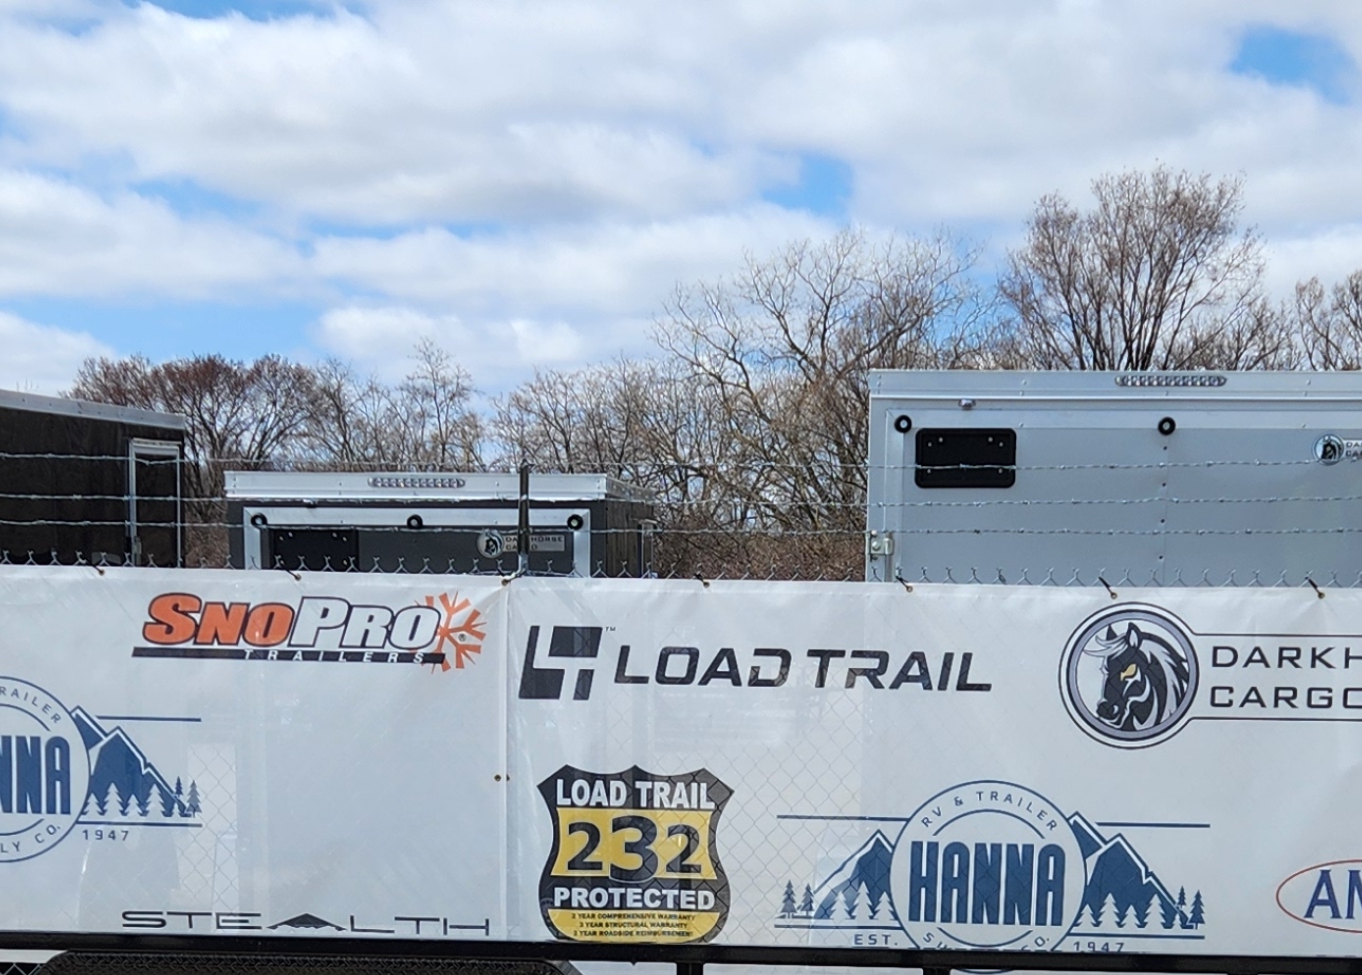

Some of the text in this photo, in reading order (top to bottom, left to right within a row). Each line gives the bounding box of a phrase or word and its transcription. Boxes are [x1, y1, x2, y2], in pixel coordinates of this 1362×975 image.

[244, 648, 425, 663] TRAILERS
[613, 643, 993, 692] LOAD TRAIL
[556, 778, 716, 810] LOAD TRAIL
[920, 790, 1058, 831] RV & TRAILER
[34, 823, 61, 844] CO.
[82, 829, 130, 841] 1947
[567, 814, 702, 884] 232
[908, 841, 1066, 926] HANNA
[553, 886, 716, 910] PROTECTED
[657, 913, 696, 921] WARRANTY
[854, 933, 898, 946] EST.
[1073, 941, 1125, 952] 1947
